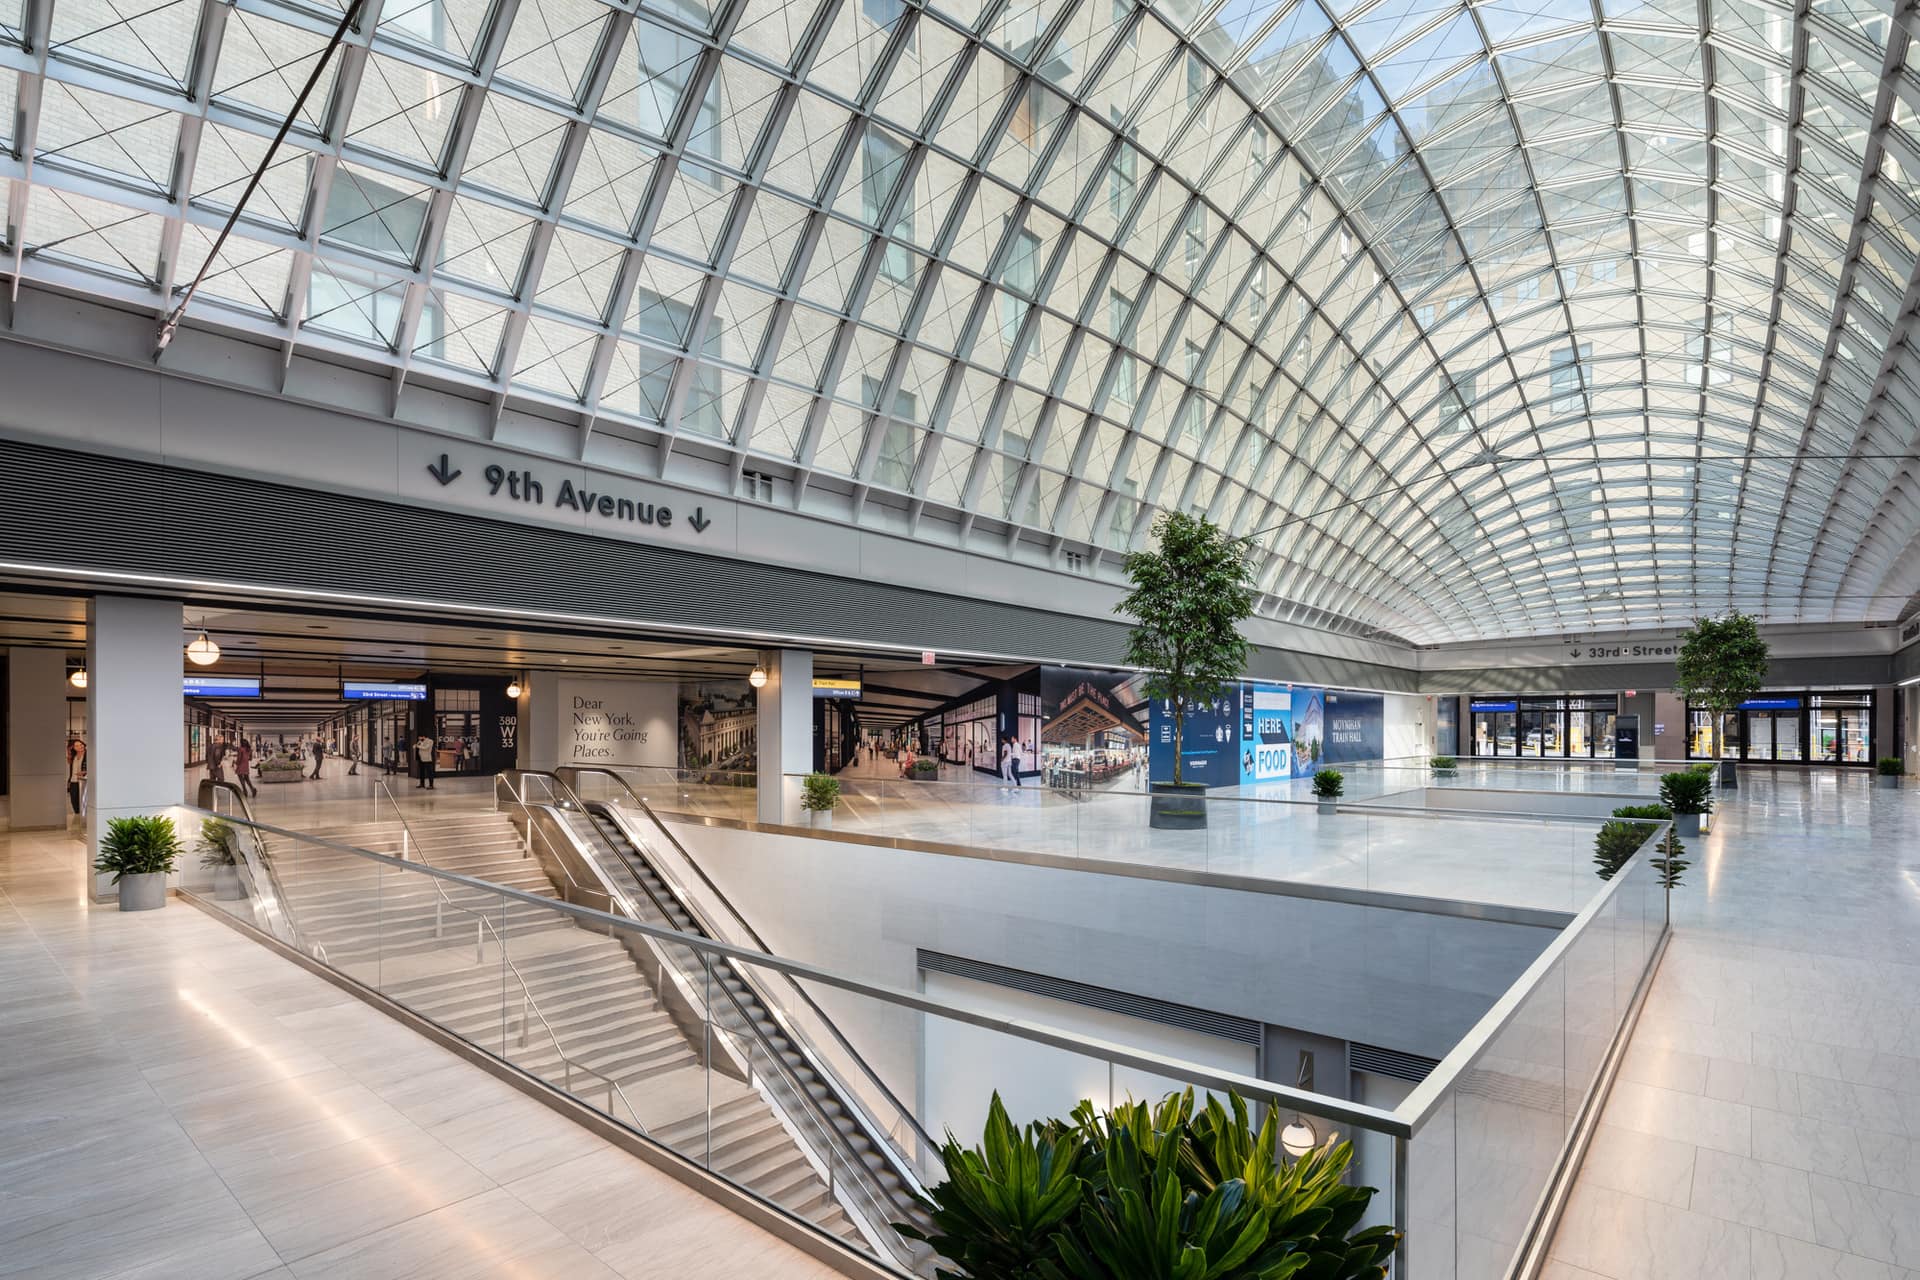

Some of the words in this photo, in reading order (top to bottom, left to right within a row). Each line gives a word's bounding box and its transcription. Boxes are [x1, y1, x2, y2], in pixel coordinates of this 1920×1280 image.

[484, 464, 544, 504] 9th
[555, 480, 673, 527] Avenue
[1589, 647, 1621, 658] 33rd
[1632, 645, 1678, 657] Street
[573, 696, 604, 709] Dear
[499, 716, 517, 726] 380
[573, 712, 602, 725] New
[500, 726, 515, 738] W
[1258, 718, 1282, 733] HERE
[574, 728, 611, 741] You're
[613, 728, 648, 744] Going
[502, 738, 514, 748] 33
[573, 744, 615, 757] Places.
[1259, 749, 1287, 772] FOOD
